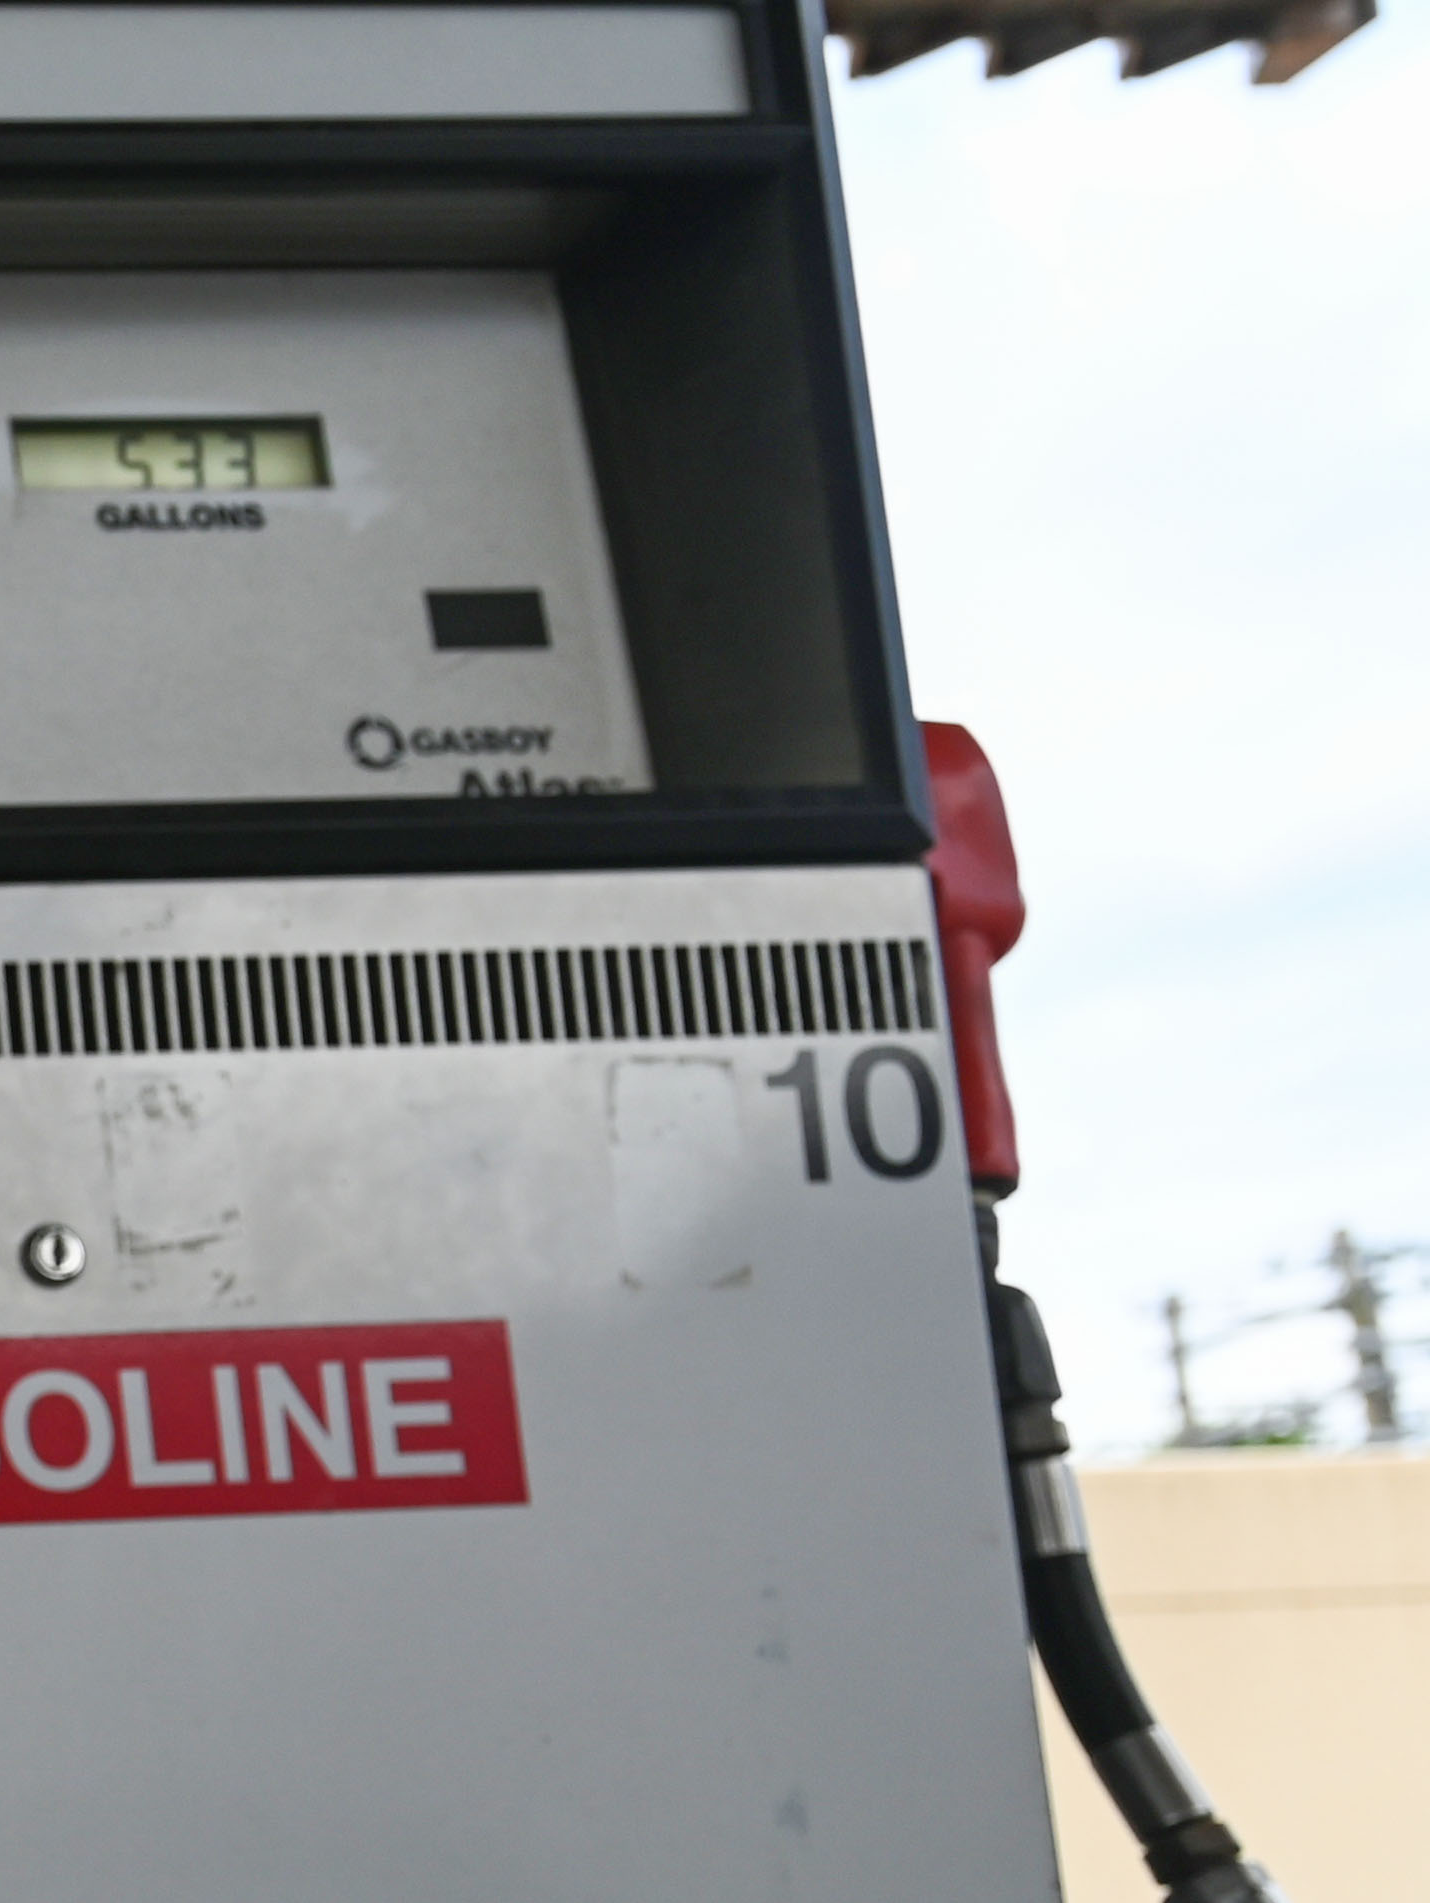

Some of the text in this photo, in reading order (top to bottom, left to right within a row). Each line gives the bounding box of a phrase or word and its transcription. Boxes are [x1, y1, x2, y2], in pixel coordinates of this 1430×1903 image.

[96, 502, 266, 530] GALLONS
[409, 725, 555, 754] GASBOY
[765, 1043, 941, 1185] 10
